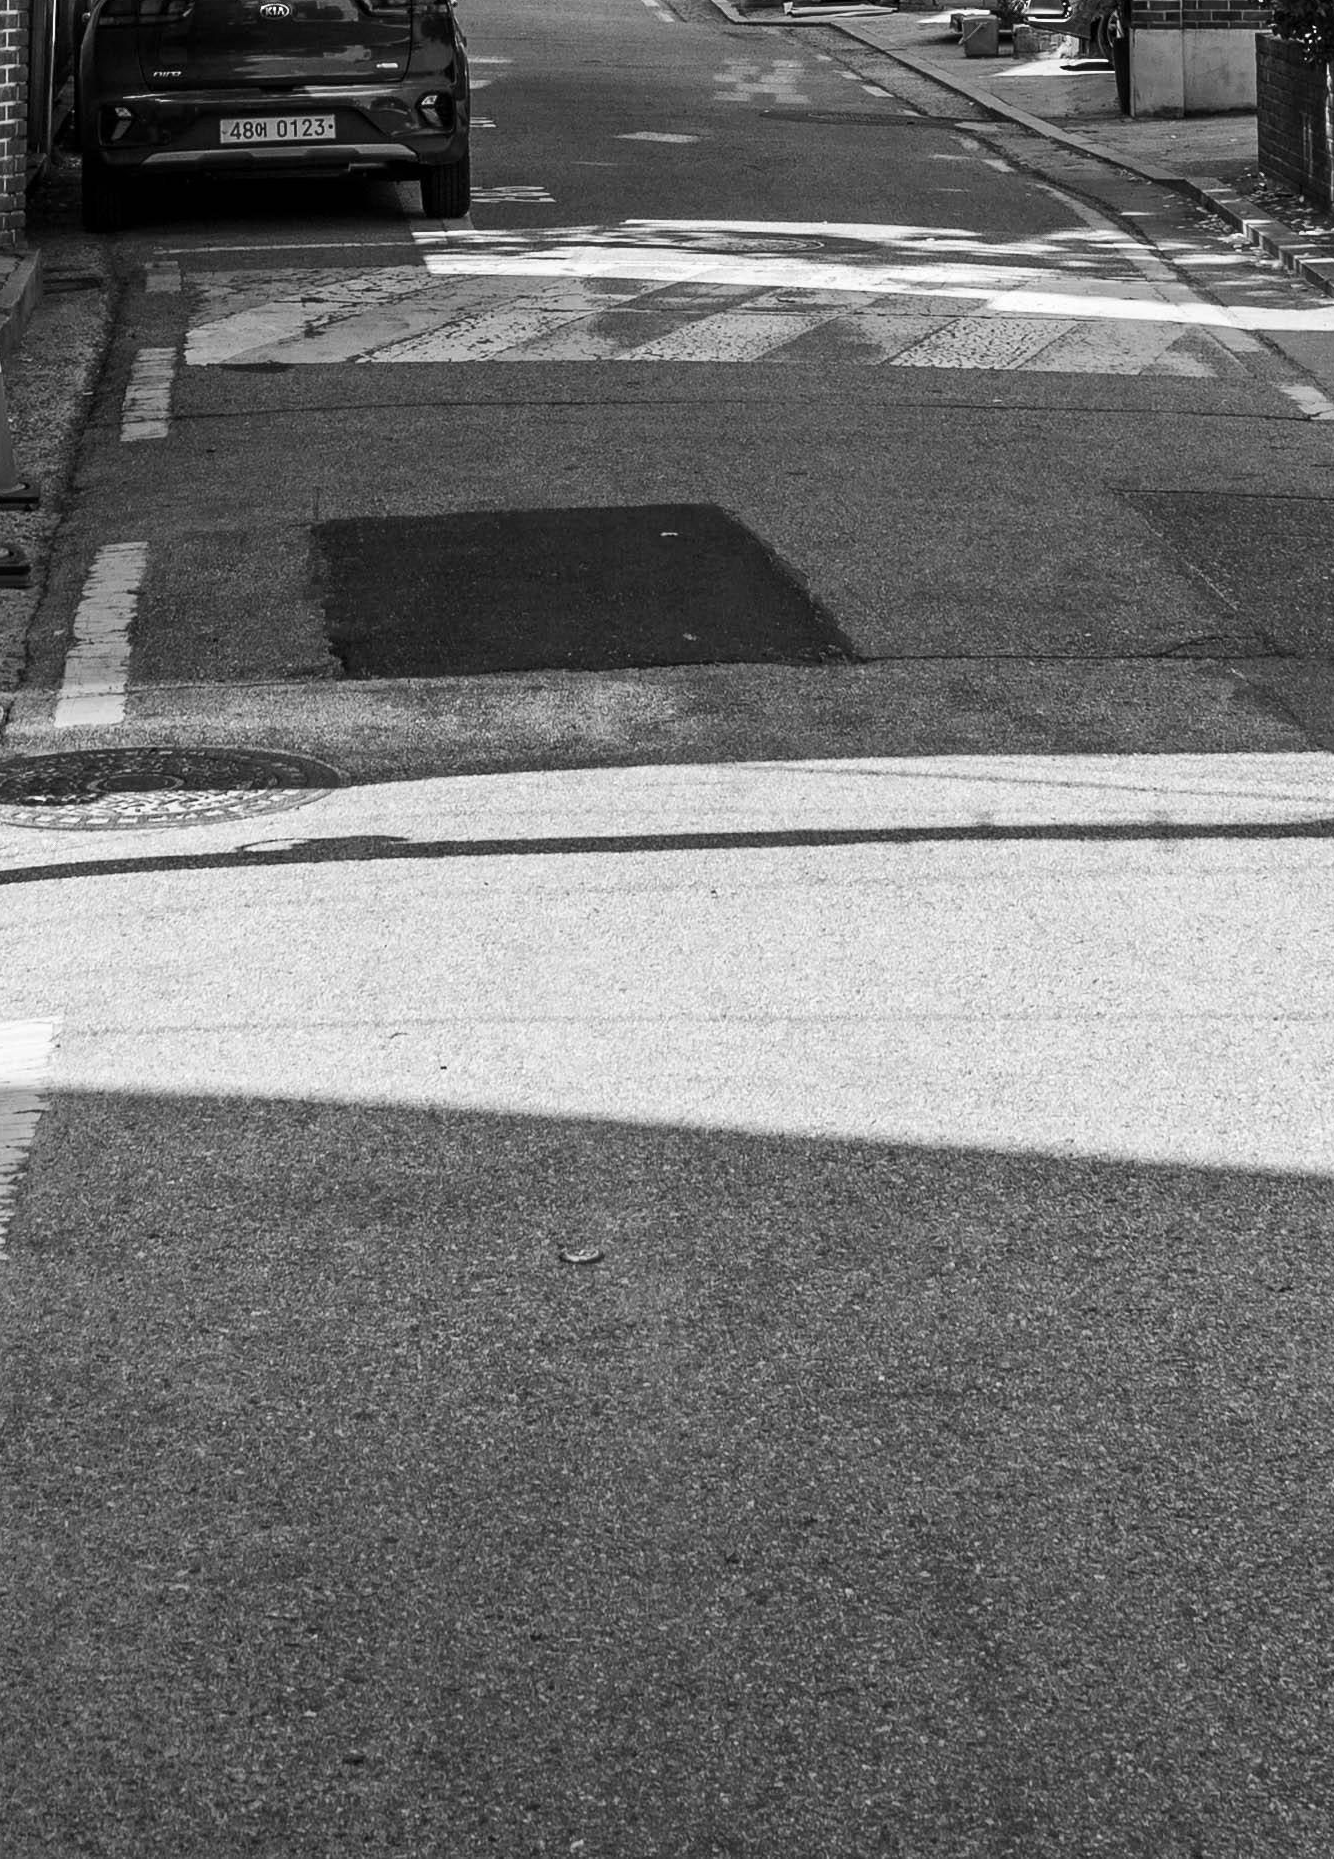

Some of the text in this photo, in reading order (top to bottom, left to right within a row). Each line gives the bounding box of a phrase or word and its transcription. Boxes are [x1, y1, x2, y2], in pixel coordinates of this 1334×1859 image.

[265, 7, 285, 16] KIA
[230, 118, 326, 140] 48어 0123
